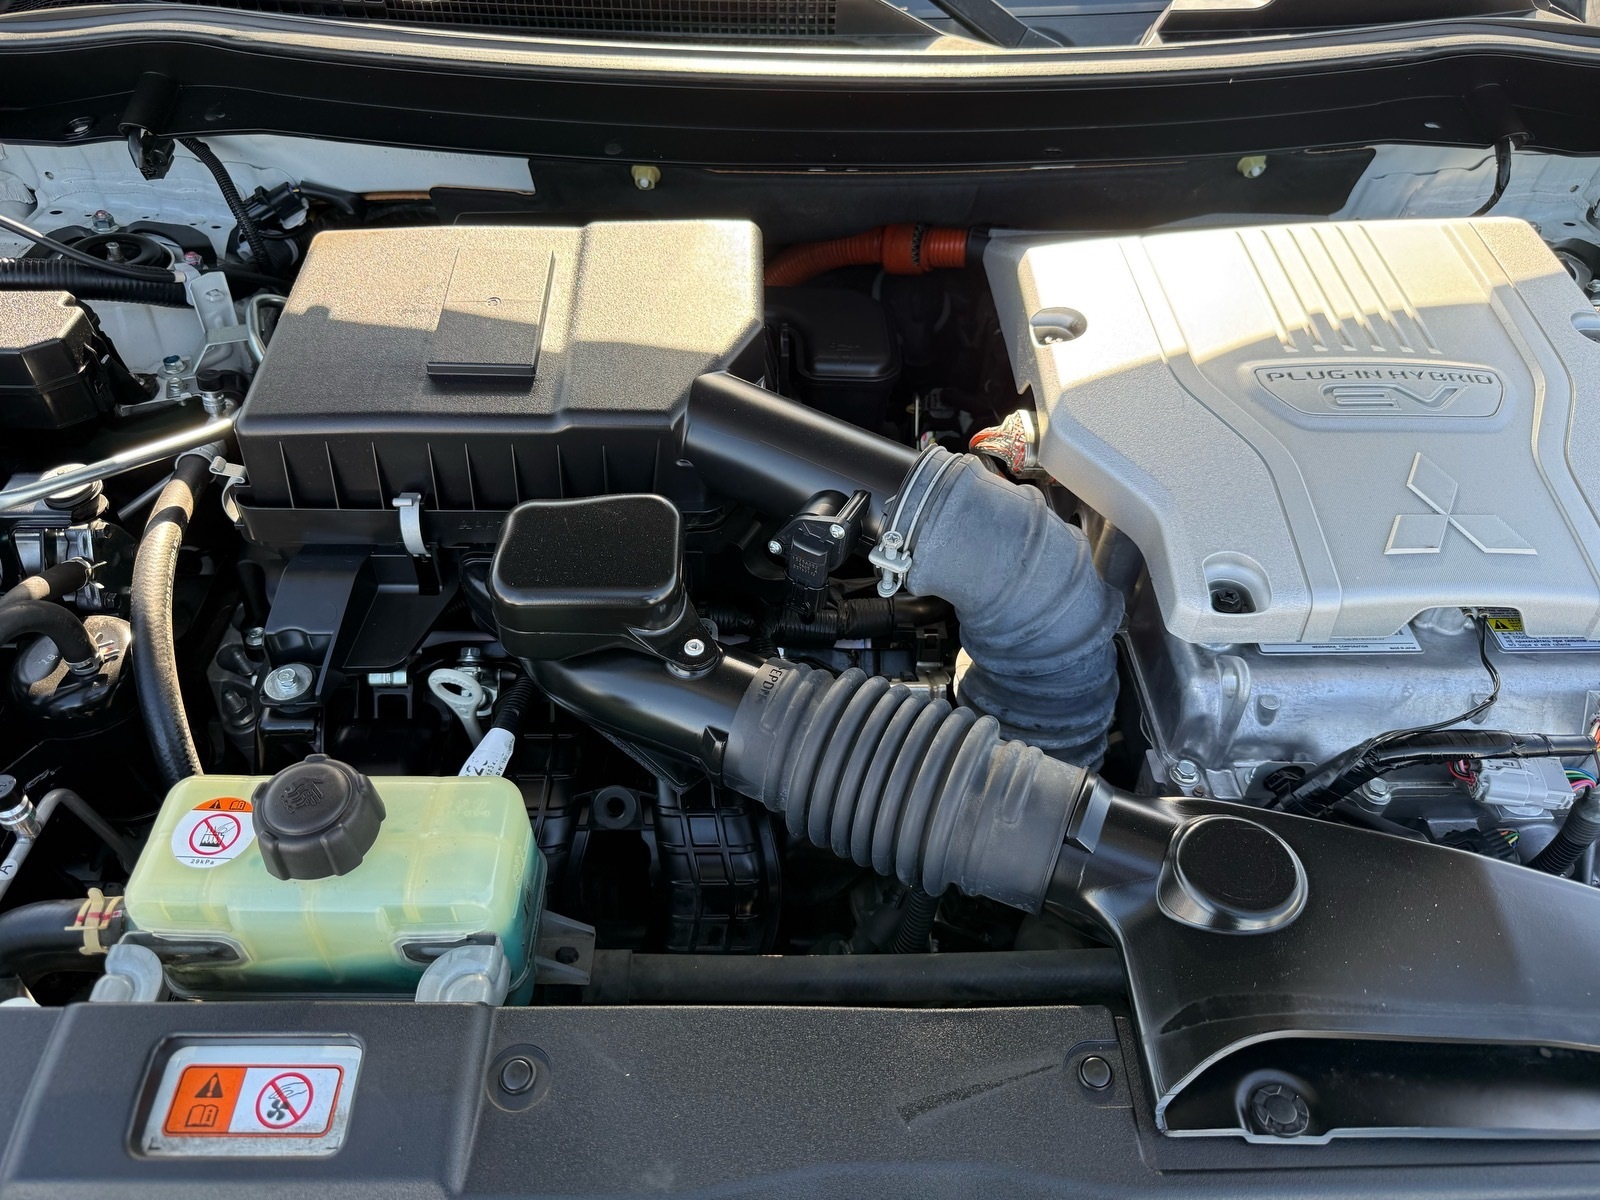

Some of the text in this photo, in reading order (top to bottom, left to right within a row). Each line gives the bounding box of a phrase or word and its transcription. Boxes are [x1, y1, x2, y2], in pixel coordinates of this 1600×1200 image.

[1265, 369, 1494, 385] PLUG-IN HYBRID
[1319, 383, 1468, 411] EV
